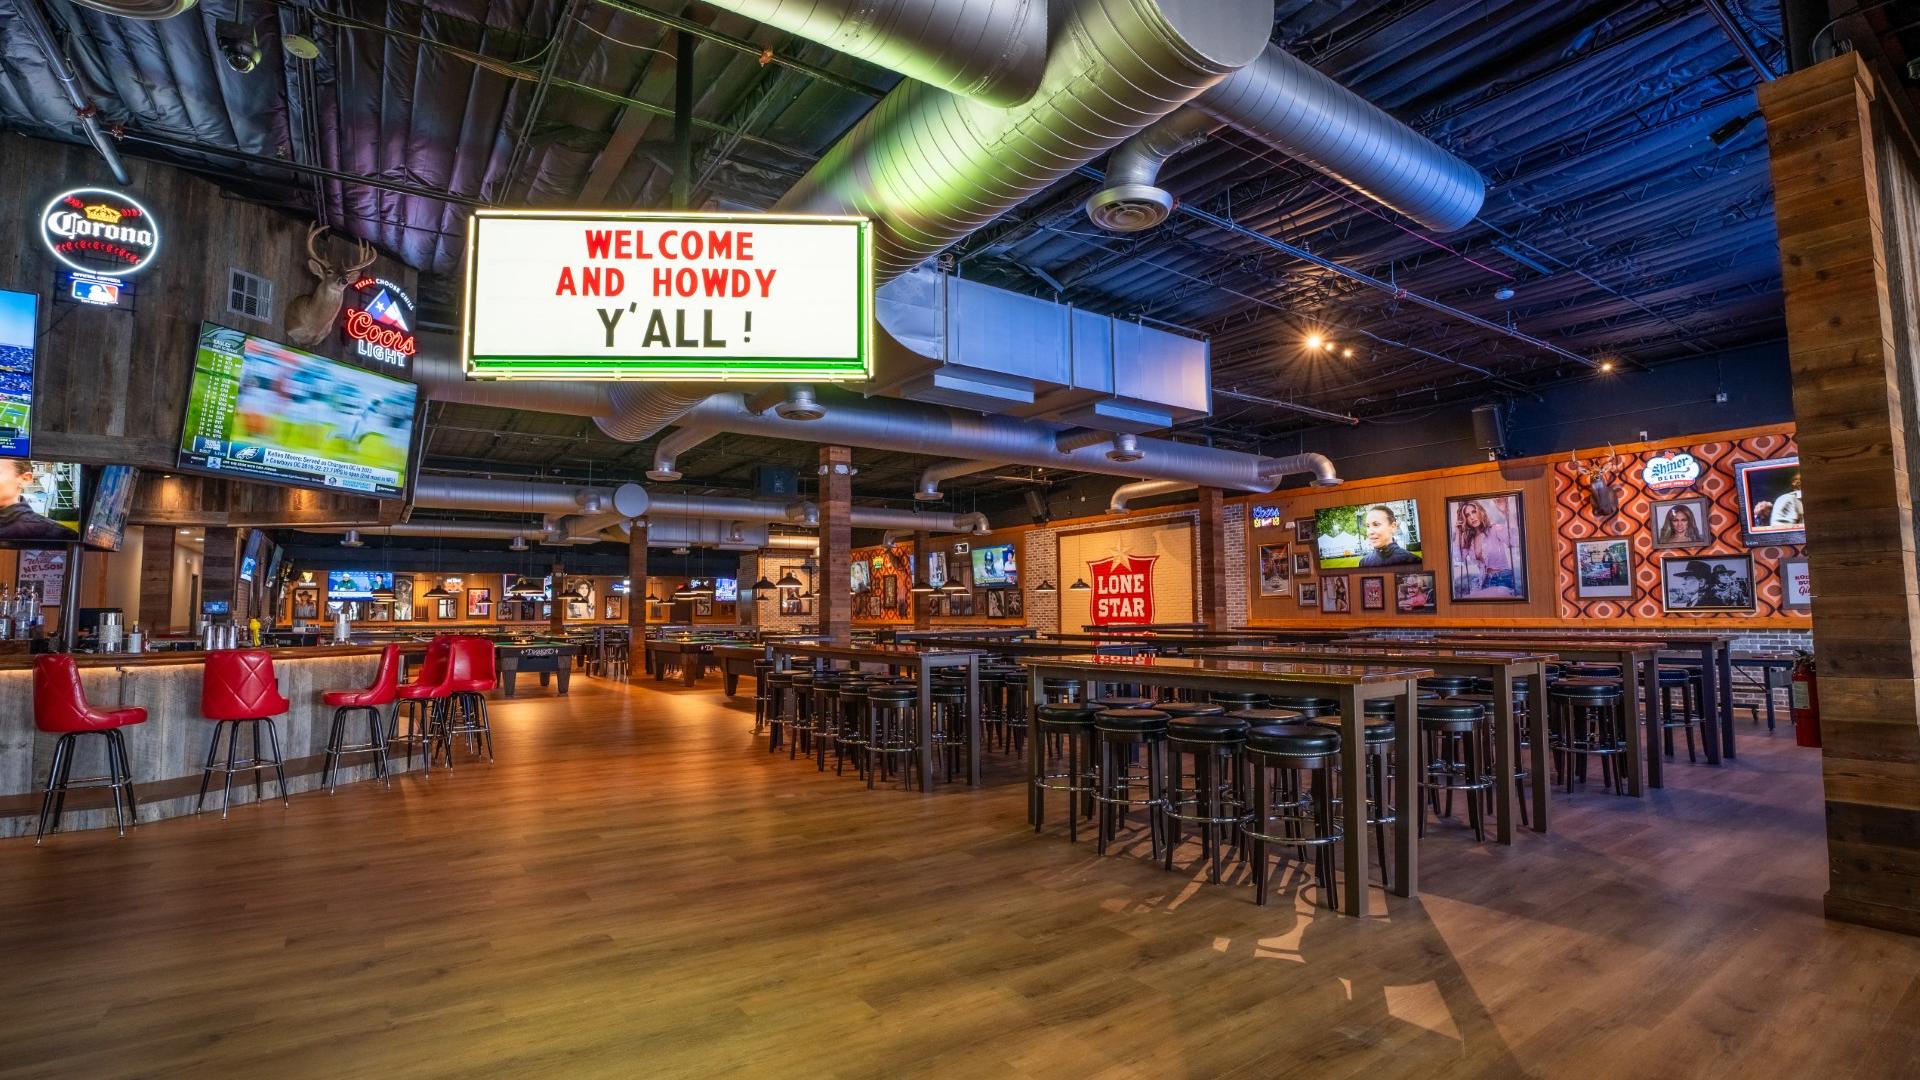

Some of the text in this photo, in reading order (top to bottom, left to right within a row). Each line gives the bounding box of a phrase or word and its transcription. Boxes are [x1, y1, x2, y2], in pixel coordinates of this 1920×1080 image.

[48, 211, 152, 246] Corona
[585, 229, 754, 261] WELCOME
[355, 278, 415, 311] TEXAS, CHOOSE CHILL
[555, 266, 777, 298] AND HOWDY
[347, 308, 416, 355] Coors
[596, 301, 726, 348] Y'ALL
[358, 339, 406, 367] LIGHT
[303, 456, 321, 464] Served
[1651, 457, 1689, 477] Shiner
[1657, 473, 1686, 482] BEERS
[23, 563, 63, 573] NELSON
[1097, 573, 1145, 595] LONE
[1098, 597, 1145, 618] STAR
